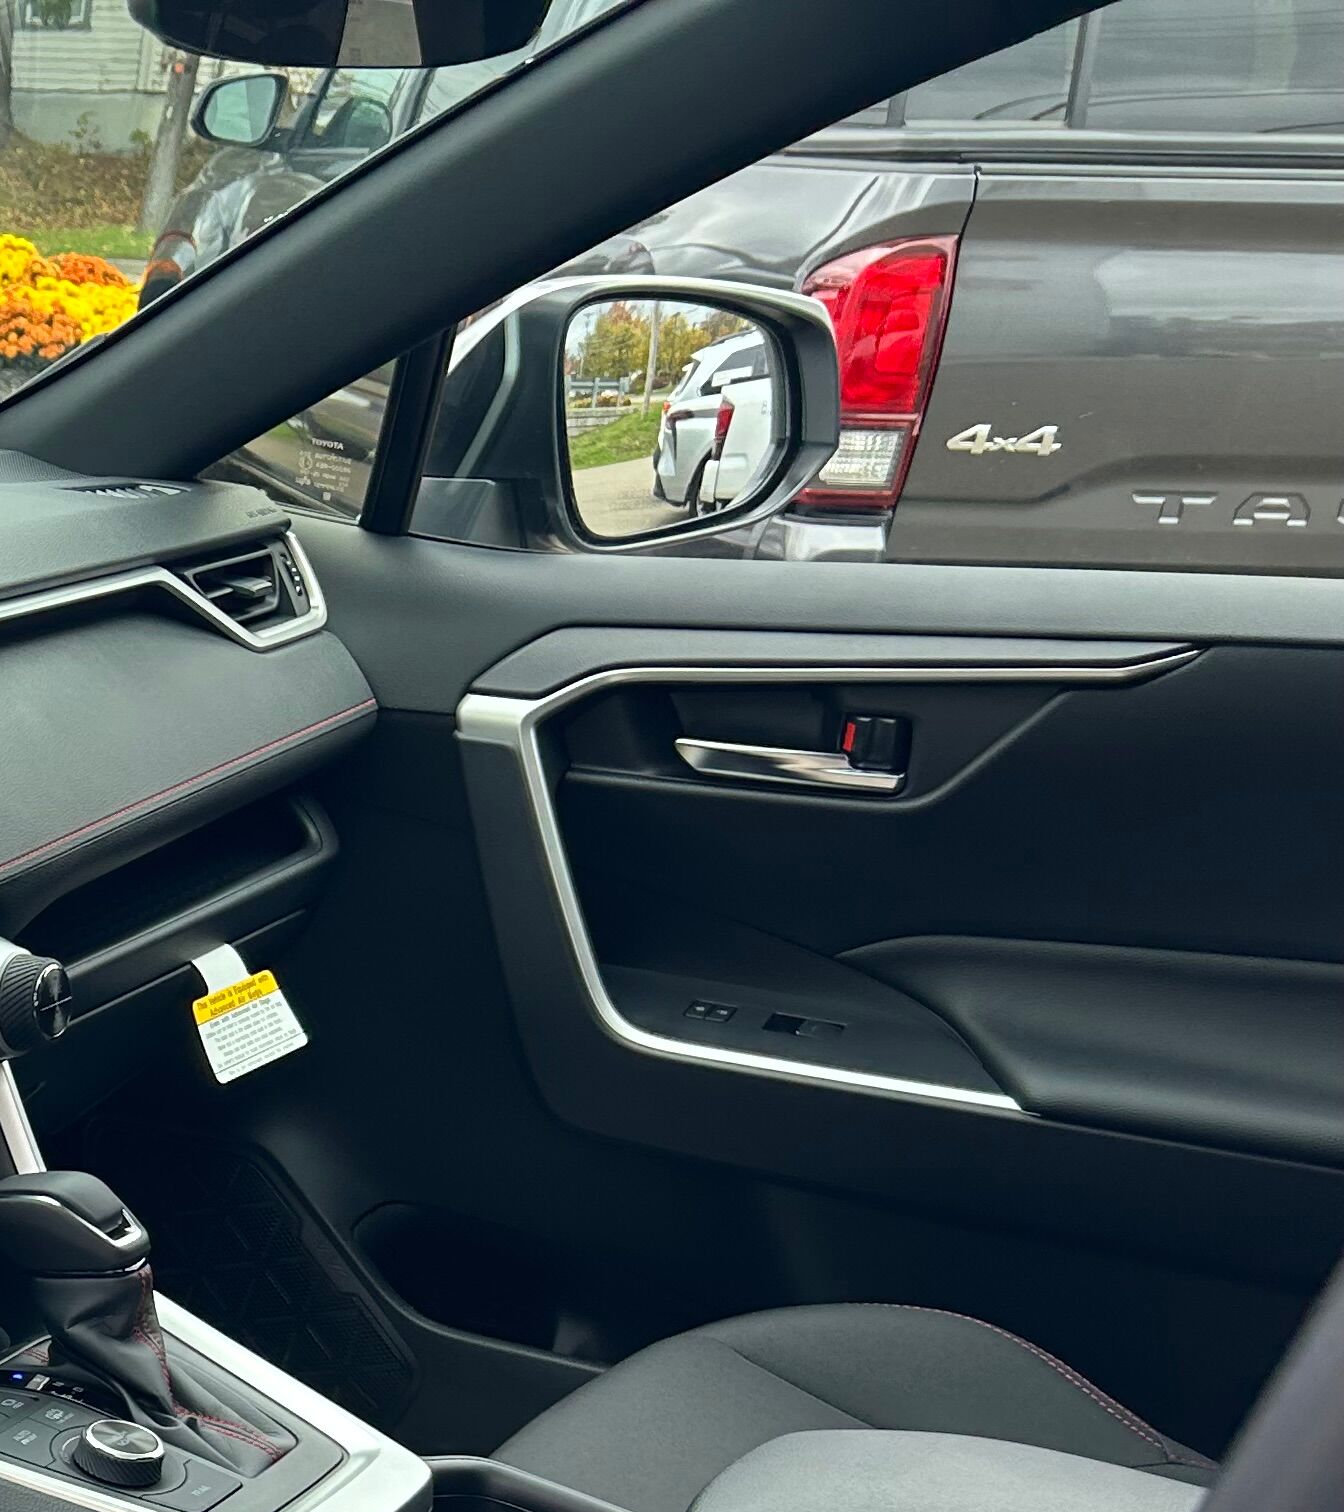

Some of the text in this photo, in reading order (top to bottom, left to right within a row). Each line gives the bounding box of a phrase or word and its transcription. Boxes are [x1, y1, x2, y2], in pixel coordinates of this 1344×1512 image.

[312, 438, 344, 451] TOYOTA
[947, 424, 1062, 456] 4x4
[1132, 489, 1344, 527] TA
